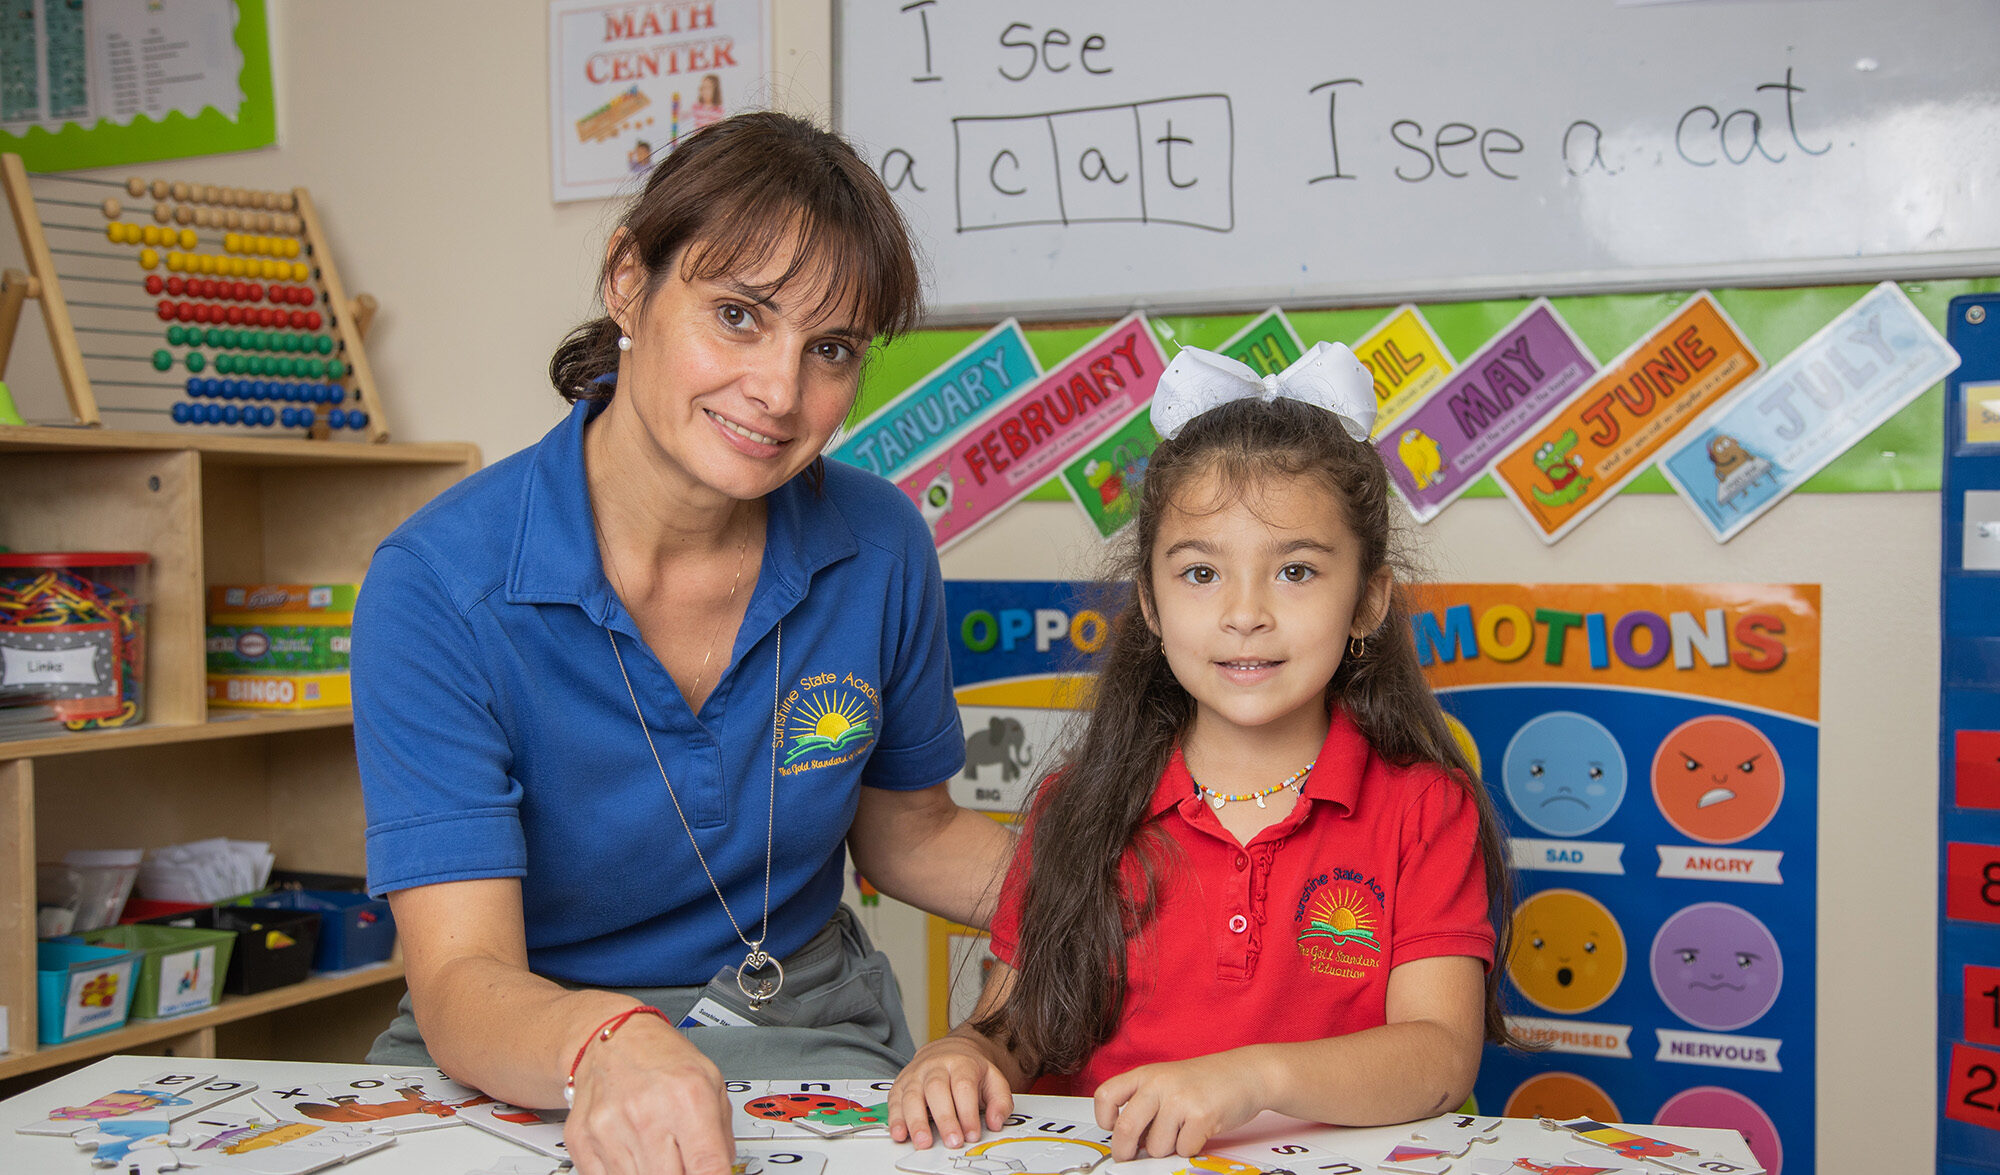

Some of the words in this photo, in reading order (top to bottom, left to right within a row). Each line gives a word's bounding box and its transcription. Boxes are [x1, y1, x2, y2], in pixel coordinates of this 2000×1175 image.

[604, 1, 716, 43] MATH
[901, 1, 943, 82] I
[998, 22, 1113, 82] see
[585, 38, 738, 84] CENTER
[1308, 79, 1364, 185] I
[1390, 119, 1525, 183] see
[1563, 119, 1622, 177] a
[881, 147, 928, 192] a
[1360, 338, 1425, 400] RIL
[1448, 335, 1545, 440] MAY
[1580, 325, 1718, 448] JUNE
[1757, 313, 1895, 441] JULY
[852, 345, 1014, 476] JANUARY
[962, 333, 1146, 486] FEBRUARY
[960, 608, 1109, 653] OPPO
[1411, 603, 1788, 673] MOTIONS
[27, 661, 64, 674] Links
[226, 680, 295, 703] BINGO
[773, 690, 799, 748] Sunshine
[800, 672, 837, 690] State
[791, 761, 811, 776] Gold
[975, 787, 1002, 801] BIG
[1546, 848, 1584, 865] SAD
[1685, 855, 1755, 875] ANGRY
[1294, 874, 1329, 923] Sunshine
[1333, 867, 1364, 884] State
[1363, 877, 1385, 914] Aca
[1310, 945, 1335, 961] Gold
[1509, 1025, 1619, 1050] SURPRISED
[1670, 1040, 1767, 1063] NERVOUS
[1963, 1064, 2000, 1113] 2
